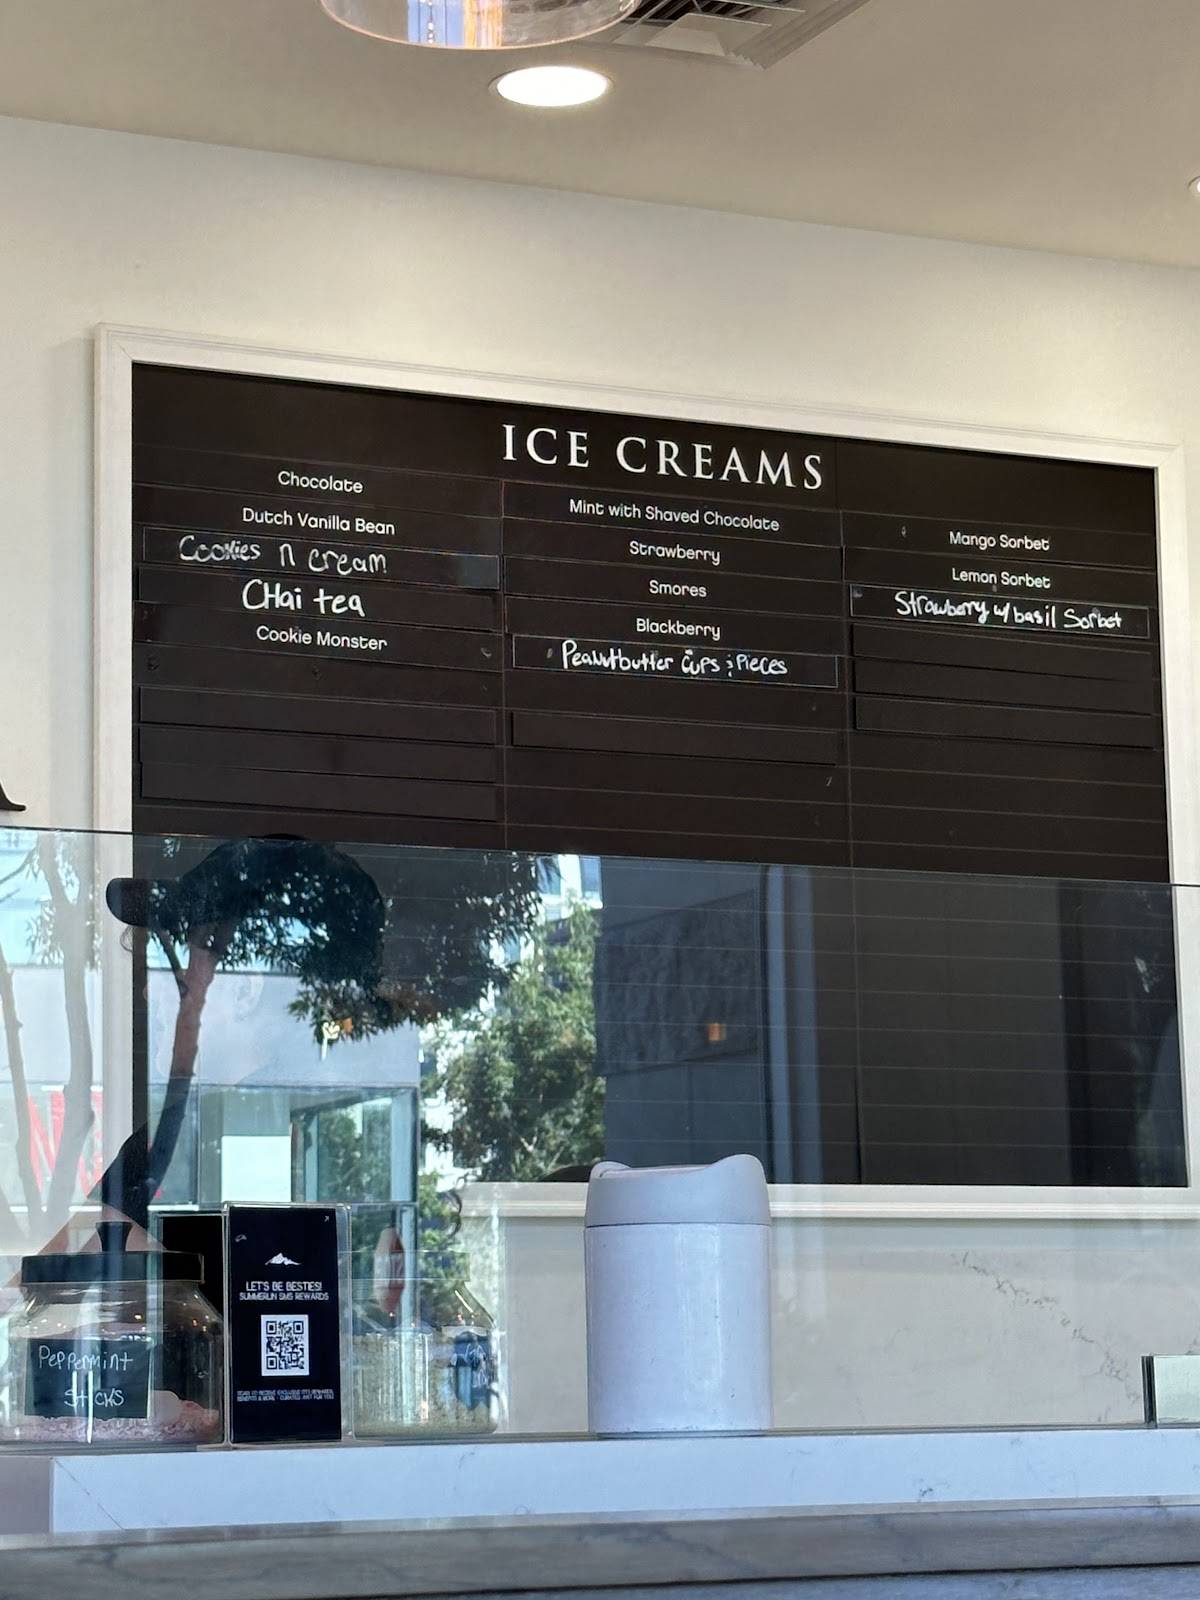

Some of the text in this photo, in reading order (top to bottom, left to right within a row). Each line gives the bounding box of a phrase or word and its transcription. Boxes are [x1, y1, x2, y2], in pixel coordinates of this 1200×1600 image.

[502, 424, 824, 490] ICE CREAMS
[277, 470, 364, 494] Chocolate
[242, 507, 395, 536] Dutch Vanilla Bean
[569, 498, 780, 532] Mint with Shaved Chocolate
[629, 540, 721, 566] Strawberry
[949, 530, 1050, 551] Mango Sorbet
[178, 534, 261, 563] Cookies
[308, 548, 387, 576] cream
[649, 579, 707, 598] Smores
[951, 567, 1051, 589] Lemon Sorbet
[312, 588, 366, 618] tea
[894, 591, 1123, 630] Strawberry w/ basil Sorbet
[256, 625, 388, 651] Cookie Monster
[636, 617, 721, 642] Blackberry
[245, 1281, 323, 1292] LET'S BE BESTIES!
[294, 1292, 329, 1301] REWARDS
[64, 1388, 125, 1408] Stcks
